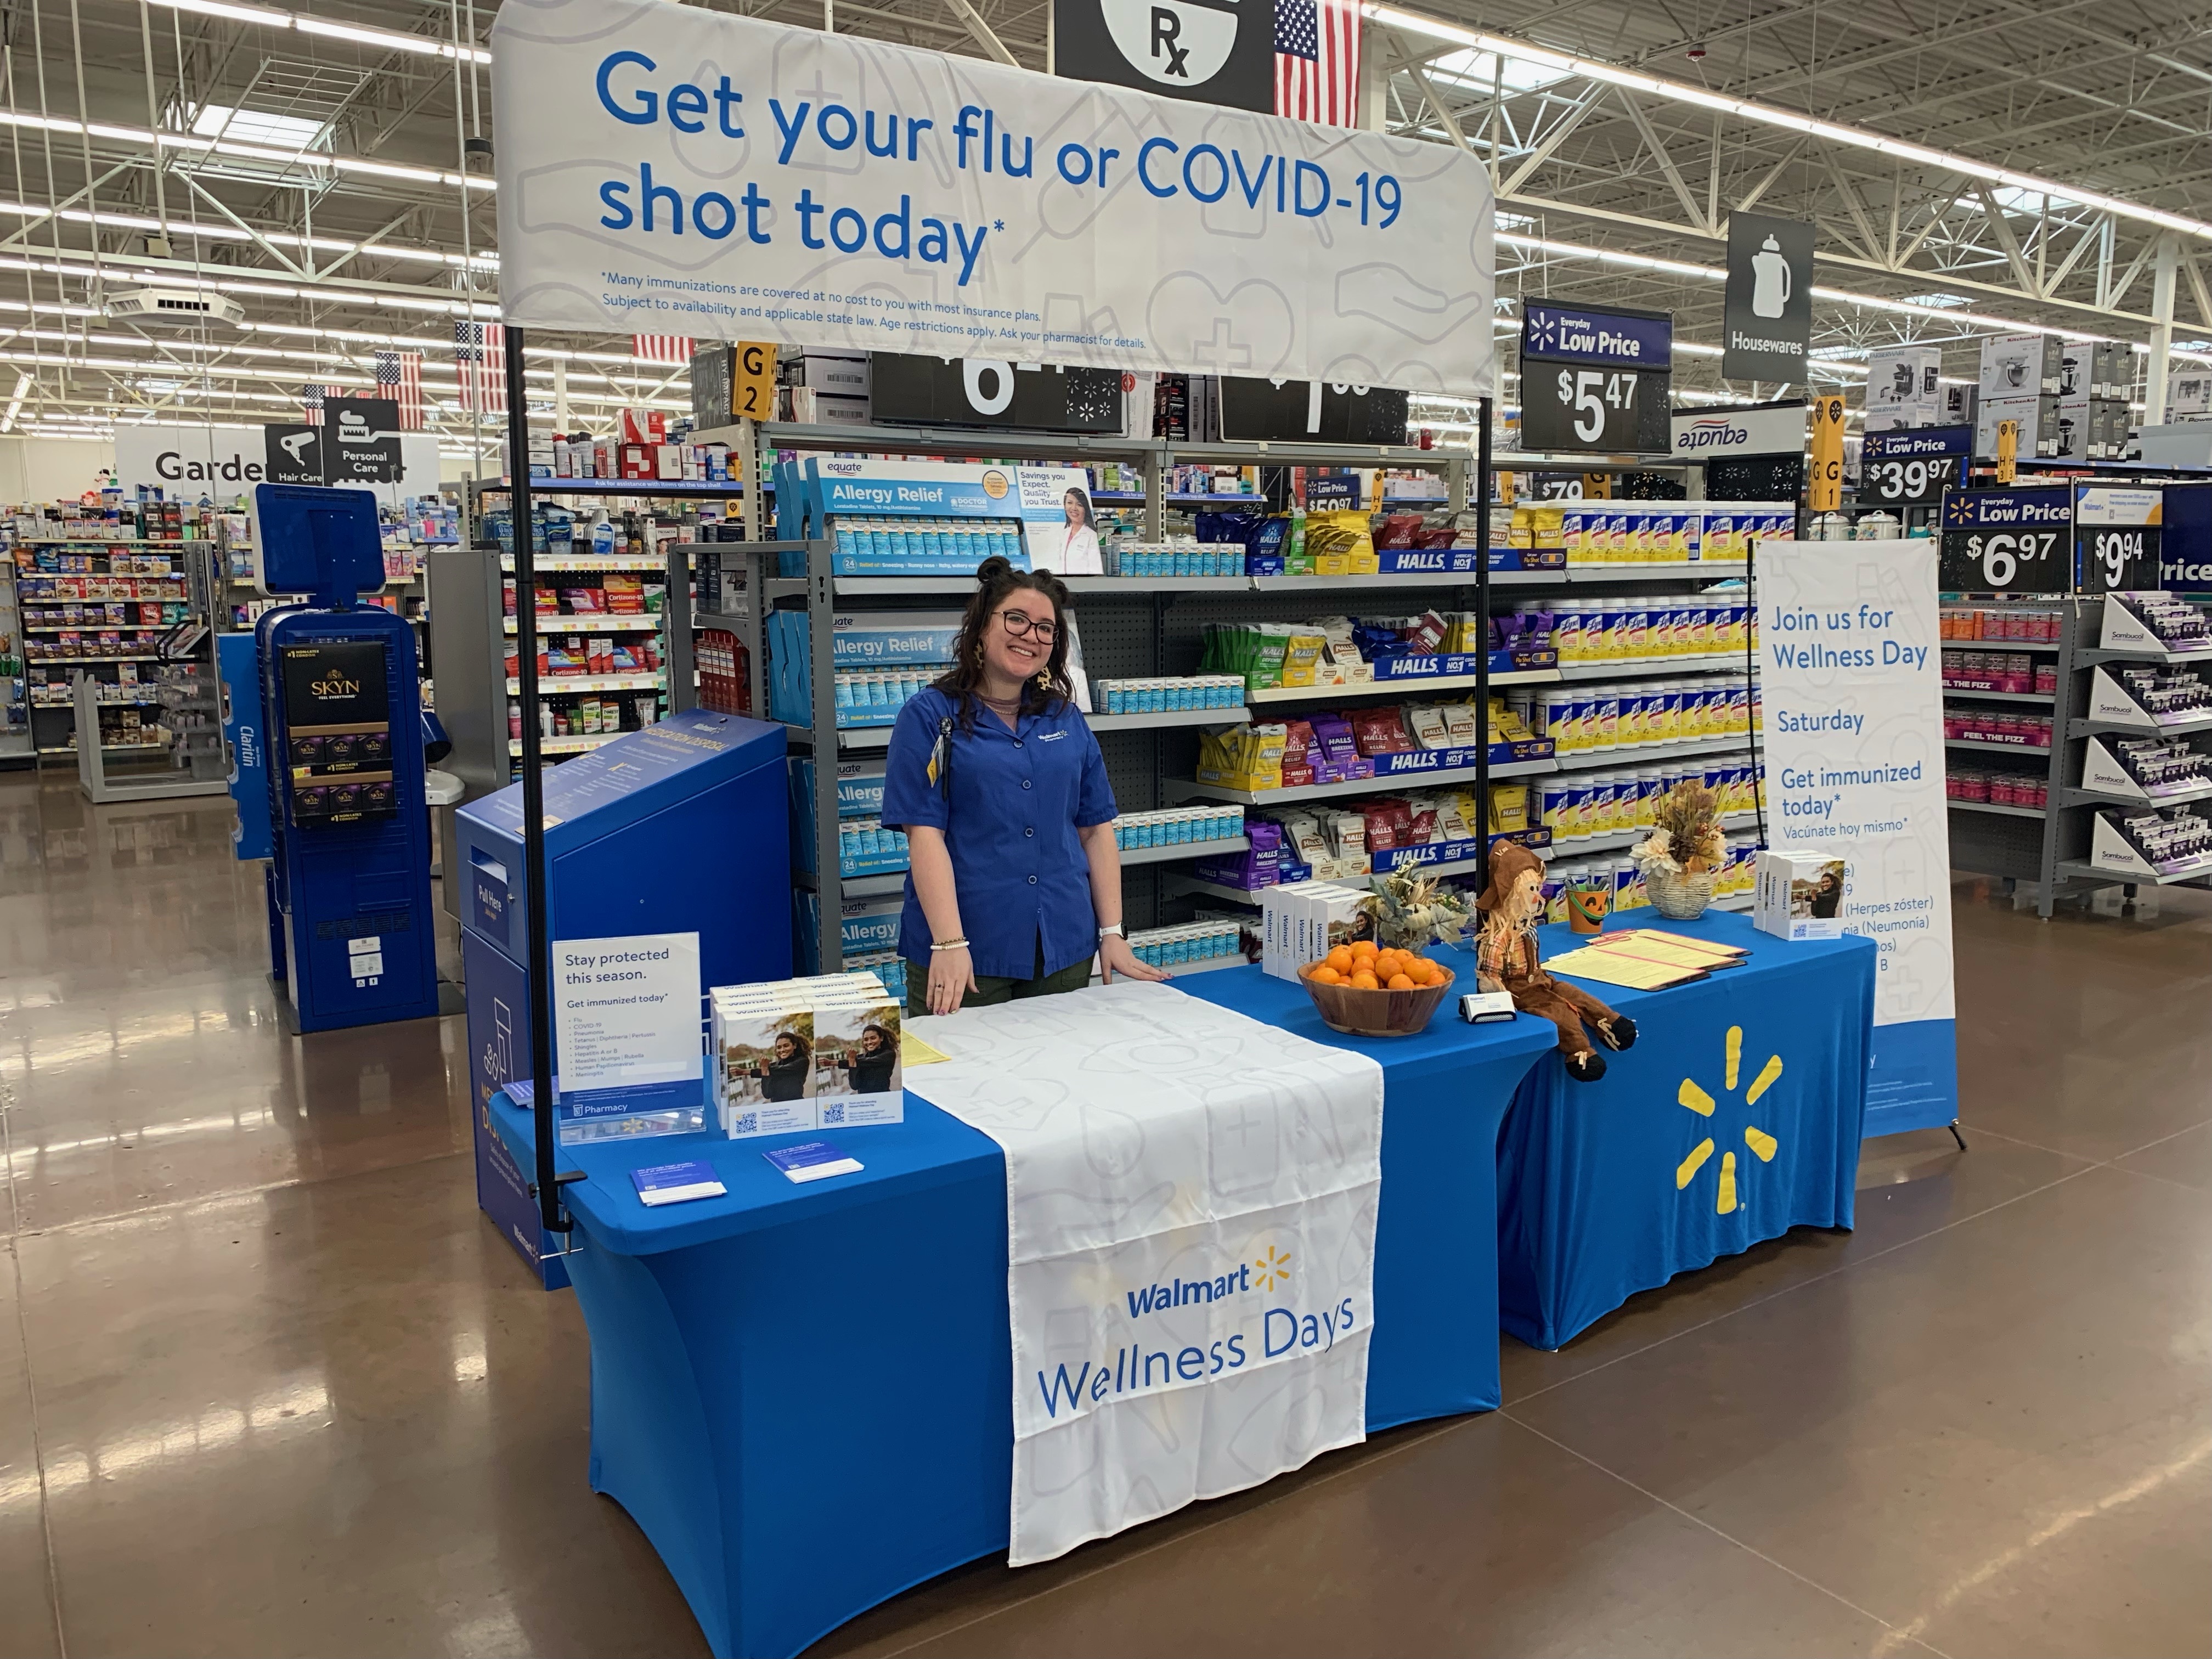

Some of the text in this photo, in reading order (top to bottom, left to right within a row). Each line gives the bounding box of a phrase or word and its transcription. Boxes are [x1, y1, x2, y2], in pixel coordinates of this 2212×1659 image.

[1152, 6, 1188, 78] Rx
[596, 50, 1402, 229] Get your flu or COVID-19
[600, 162, 770, 245] shot
[647, 275, 736, 294] immunizations
[740, 285, 759, 296] are
[763, 287, 810, 300] covered
[813, 291, 825, 301] at
[829, 293, 842, 302] no
[845, 295, 867, 306] cost
[871, 295, 882, 307] to
[885, 299, 905, 311] you
[908, 300, 932, 312] with
[935, 304, 960, 314] most
[963, 305, 1012, 319] insurance
[1015, 309, 1041, 322] plans.
[603, 293, 1146, 349] Subject to availability and applicable state law. Age restrictions apply. Ask your pharmacist for details.
[1560, 317, 1591, 331] Everyday
[1559, 327, 1640, 357] Low Price
[1732, 330, 1803, 356] Housewares
[743, 347, 764, 375] G
[1869, 349, 1906, 359] FARBERWARE
[743, 386, 757, 413] 2
[1678, 424, 1748, 450] equate
[1886, 439, 1946, 454] Low Price
[342, 450, 387, 461] Personal
[1999, 456, 2005, 466] H
[155, 452, 267, 482] Garde
[353, 463, 378, 473] Care
[827, 462, 862, 475] equate
[1020, 471, 1050, 481] Savings
[1826, 461, 1839, 481] G
[279, 472, 323, 482] Hair Care
[833, 484, 943, 503] Allergy Relief
[1023, 489, 1051, 498] Quality
[1318, 483, 1348, 494] Low Price
[1829, 488, 1833, 505] 1
[1980, 498, 2014, 506] Everyday
[1979, 503, 2071, 522] Low Price
[1771, 604, 1893, 631] Join us for
[1773, 640, 1928, 670] Wellness Day
[312, 680, 360, 695] SKYN
[1778, 709, 1864, 736] Saturday
[1964, 732, 1985, 740] FEEL
[240, 726, 255, 766] Claritin
[1781, 761, 1921, 790] Get immunized
[1784, 824, 1836, 839] Vacúnate
[1840, 821, 1860, 838] hoy
[479, 884, 502, 912] Pull Here
[1846, 895, 1933, 917] (Herpes zóster)
[1863, 915, 1929, 935] (Neumonía)
[566, 948, 669, 968] Stay protected
[1881, 959, 1888, 970] B
[566, 970, 647, 984] this season.
[567, 1000, 584, 1008] Get
[587, 996, 636, 1007] immunized
[600, 1034, 628, 1042] Diphtheria
[585, 1104, 628, 1114] Pharmacy
[1128, 1263, 1250, 1318] Walmart
[1038, 1297, 1354, 1418] Wellness Days
